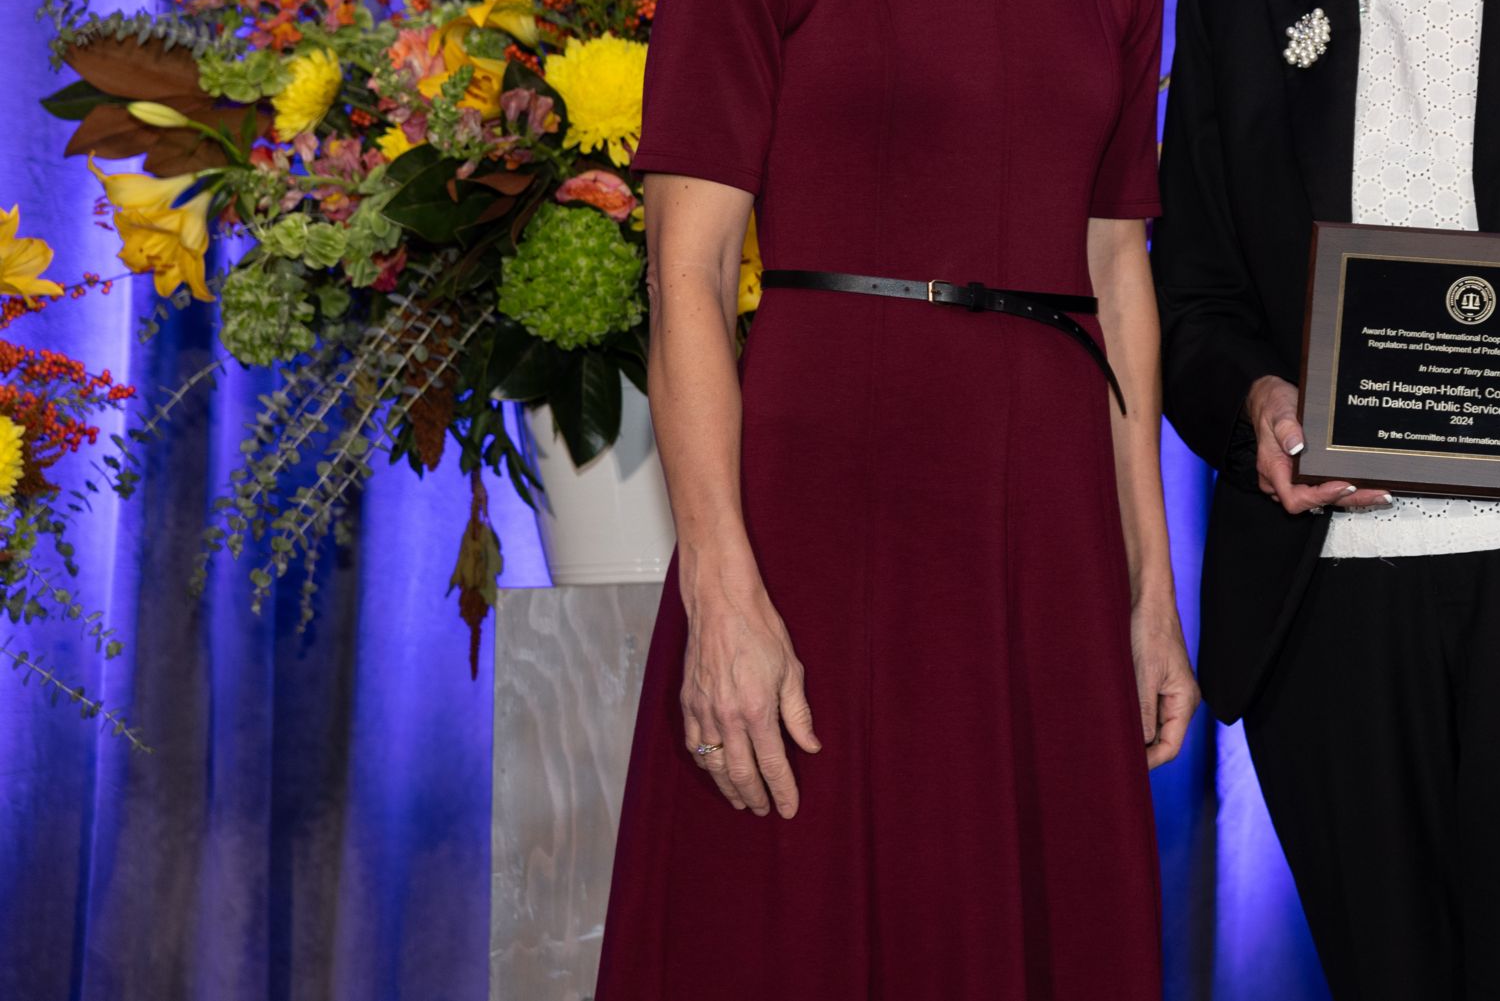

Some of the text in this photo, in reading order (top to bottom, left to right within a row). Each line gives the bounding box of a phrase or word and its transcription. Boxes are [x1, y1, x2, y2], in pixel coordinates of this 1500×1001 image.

[1362, 326, 1386, 336] Award
[1387, 328, 1397, 336] for
[1398, 329, 1435, 340] Promoting
[1436, 331, 1480, 342] International
[1368, 339, 1407, 350] Regulators
[1424, 343, 1472, 354] Development
[1473, 346, 1481, 354] of
[1418, 364, 1427, 372] In
[1428, 365, 1452, 374] Honor
[1463, 367, 1483, 378] Terry
[1360, 379, 1390, 391] Sheri
[1393, 381, 1482, 400] Haugen-Hoffart,
[1348, 394, 1379, 407] North
[1382, 396, 1422, 410] Dakota
[1425, 399, 1460, 412] Public
[1450, 415, 1474, 426] 2024
[1377, 430, 1389, 440] By
[1390, 430, 1402, 439] the
[1404, 432, 1445, 442] Committee
